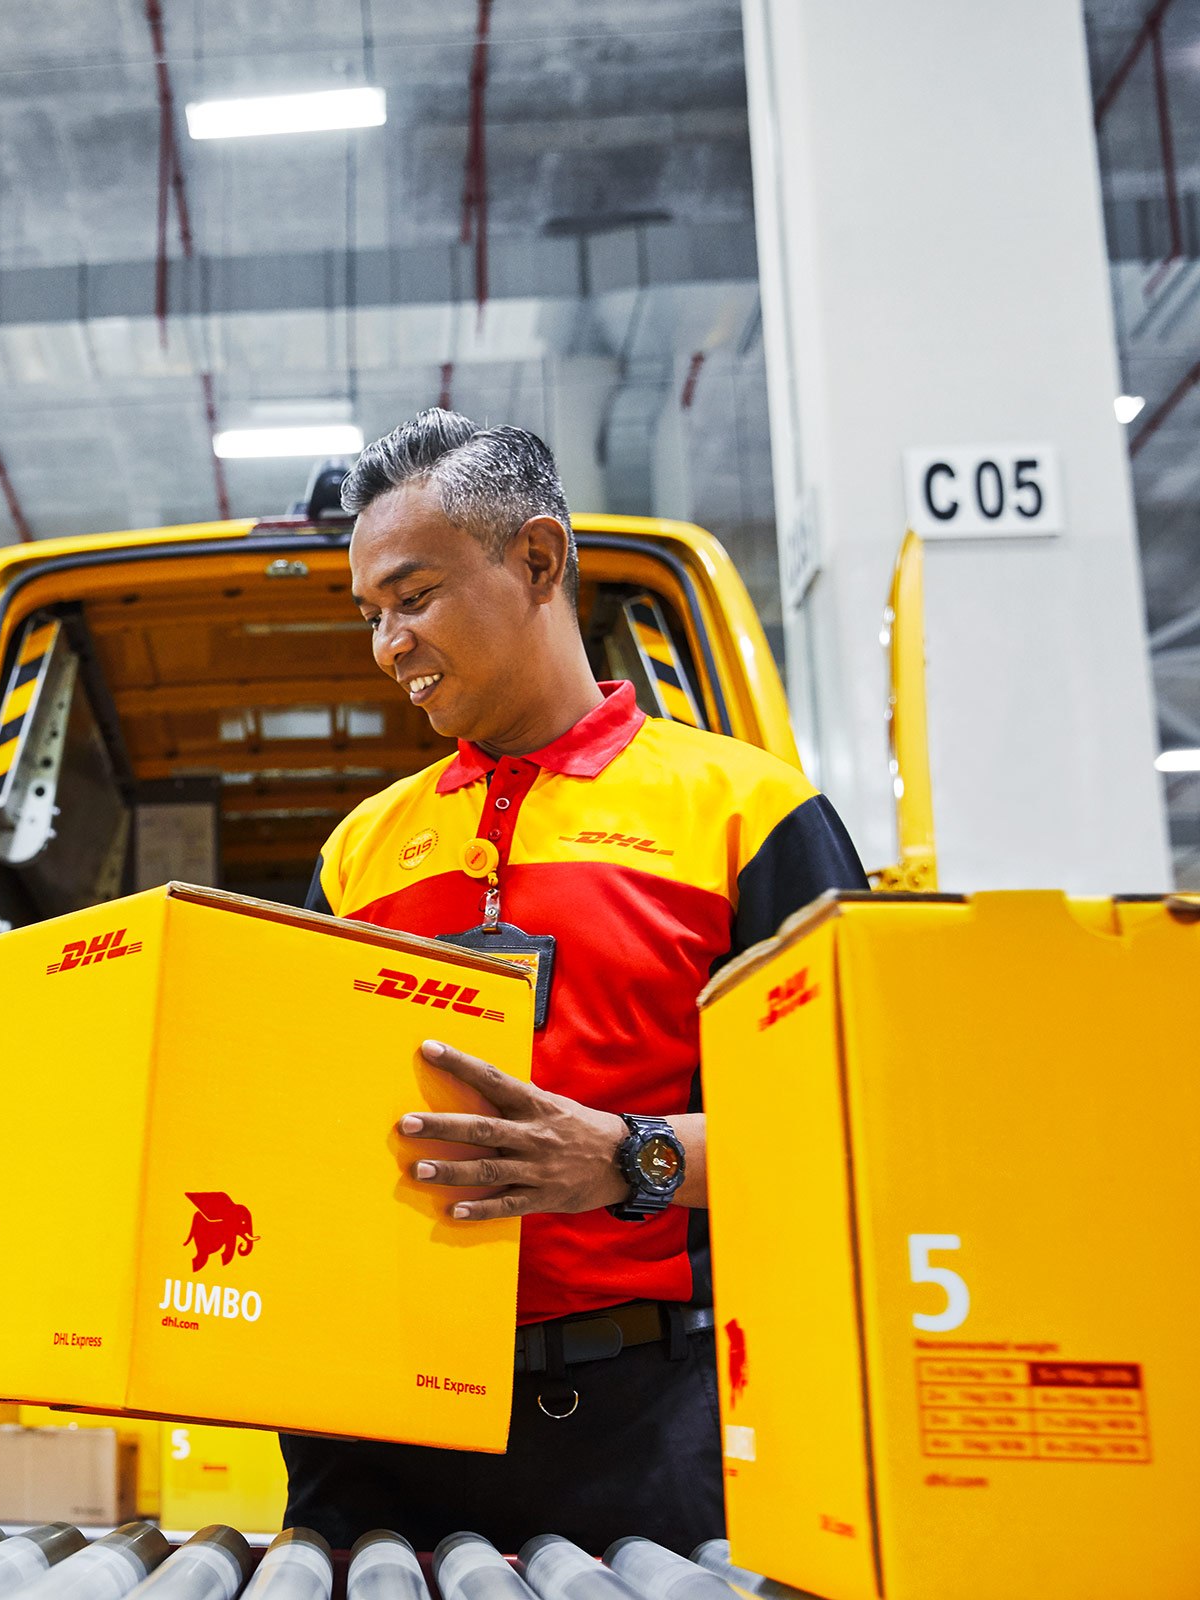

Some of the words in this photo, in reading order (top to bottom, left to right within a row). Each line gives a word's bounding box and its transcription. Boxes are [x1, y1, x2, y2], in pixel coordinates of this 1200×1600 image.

[922, 460, 959, 522] C
[974, 458, 1043, 520] 05
[403, 838, 433, 861] CIS
[574, 831, 658, 854] DHL
[58, 928, 128, 973] DHL
[373, 967, 486, 1018] DHL
[907, 1233, 971, 1333] 5
[159, 1278, 263, 1322] JUMBO
[161, 1316, 199, 1331] dhl.com
[53, 1332, 69, 1346] DHL
[71, 1333, 102, 1349] Express
[416, 1373, 441, 1390] DHL
[443, 1377, 487, 1396] Express
[170, 1428, 191, 1461] 5
